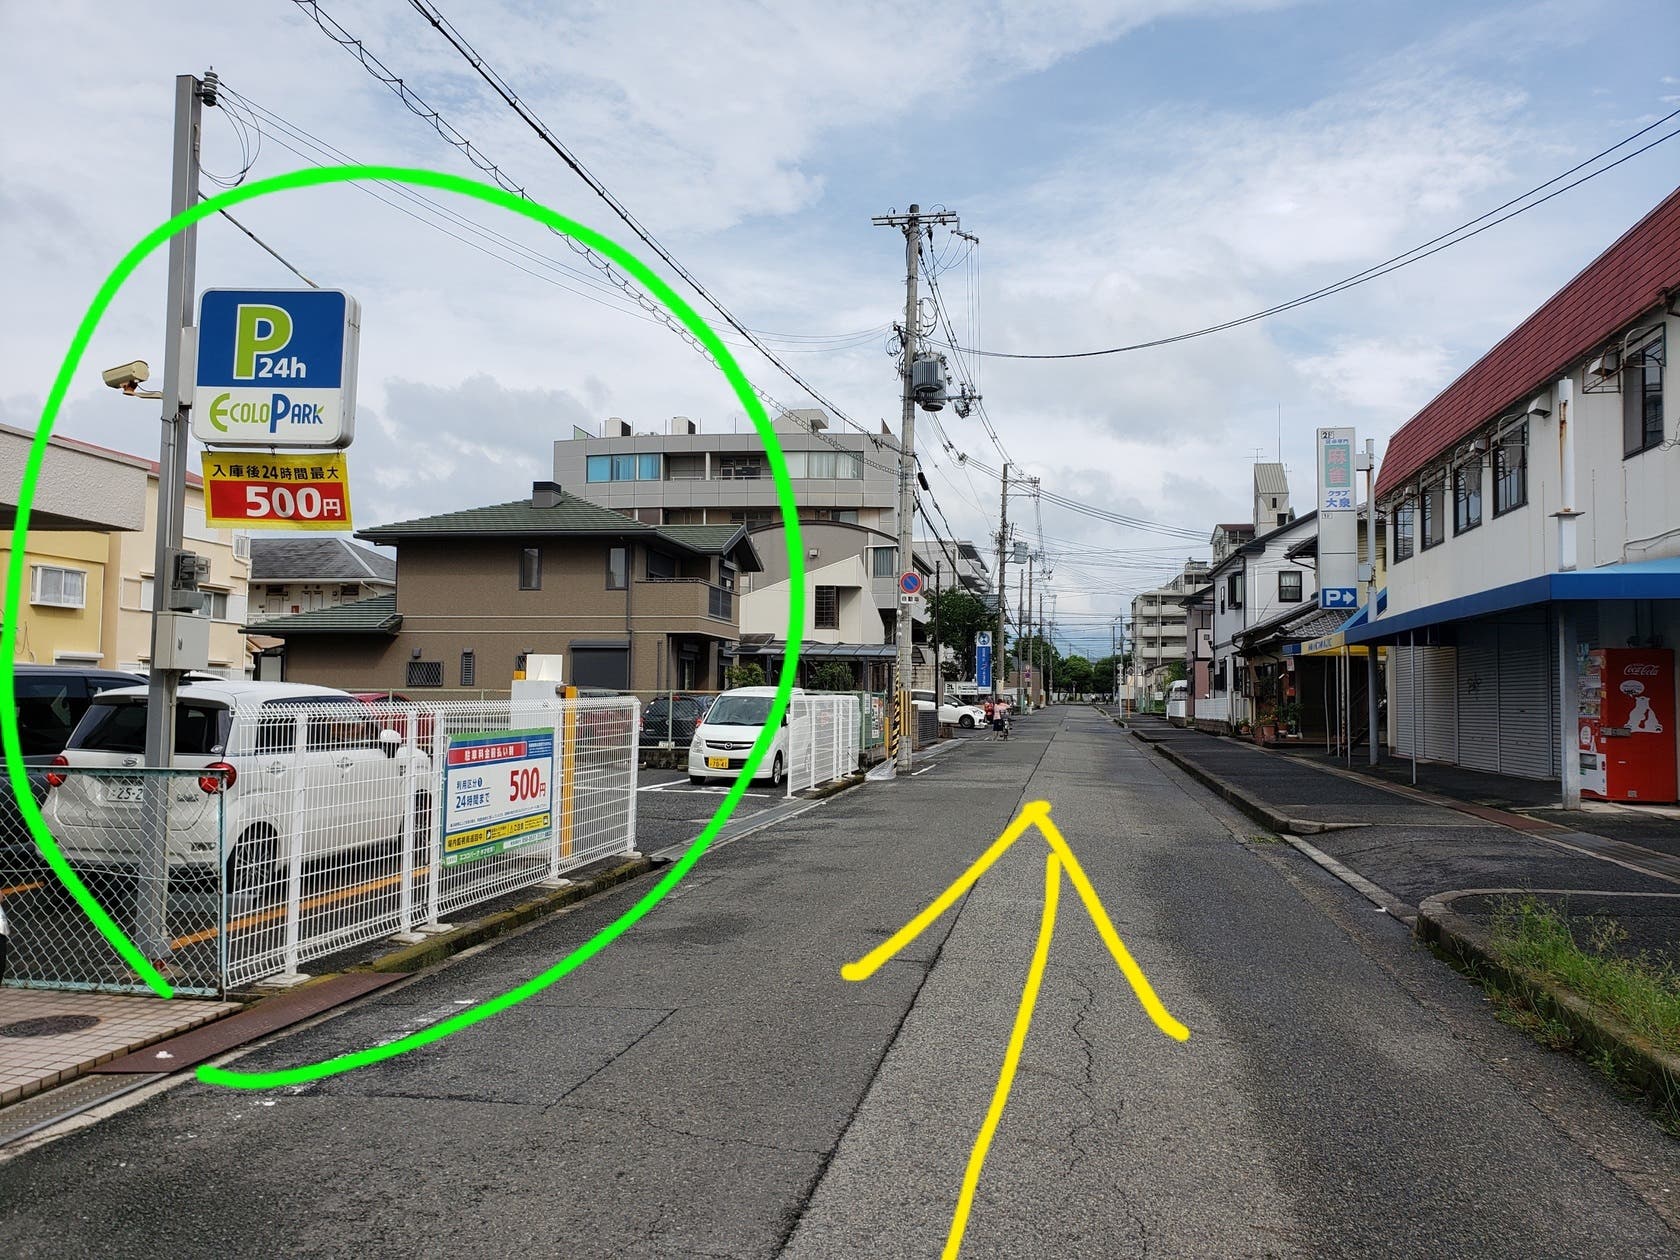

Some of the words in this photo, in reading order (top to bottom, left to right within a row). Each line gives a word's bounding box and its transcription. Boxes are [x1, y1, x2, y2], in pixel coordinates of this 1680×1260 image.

[233, 304, 294, 380] P
[258, 357, 307, 379] 24h
[211, 464, 340, 481] 入庫後24時間最大
[245, 486, 342, 519] 500円
[1326, 497, 1351, 508] 大泉
[1325, 590, 1342, 607] P
[509, 767, 547, 802] 500円
[456, 792, 490, 809] 24時間まで
